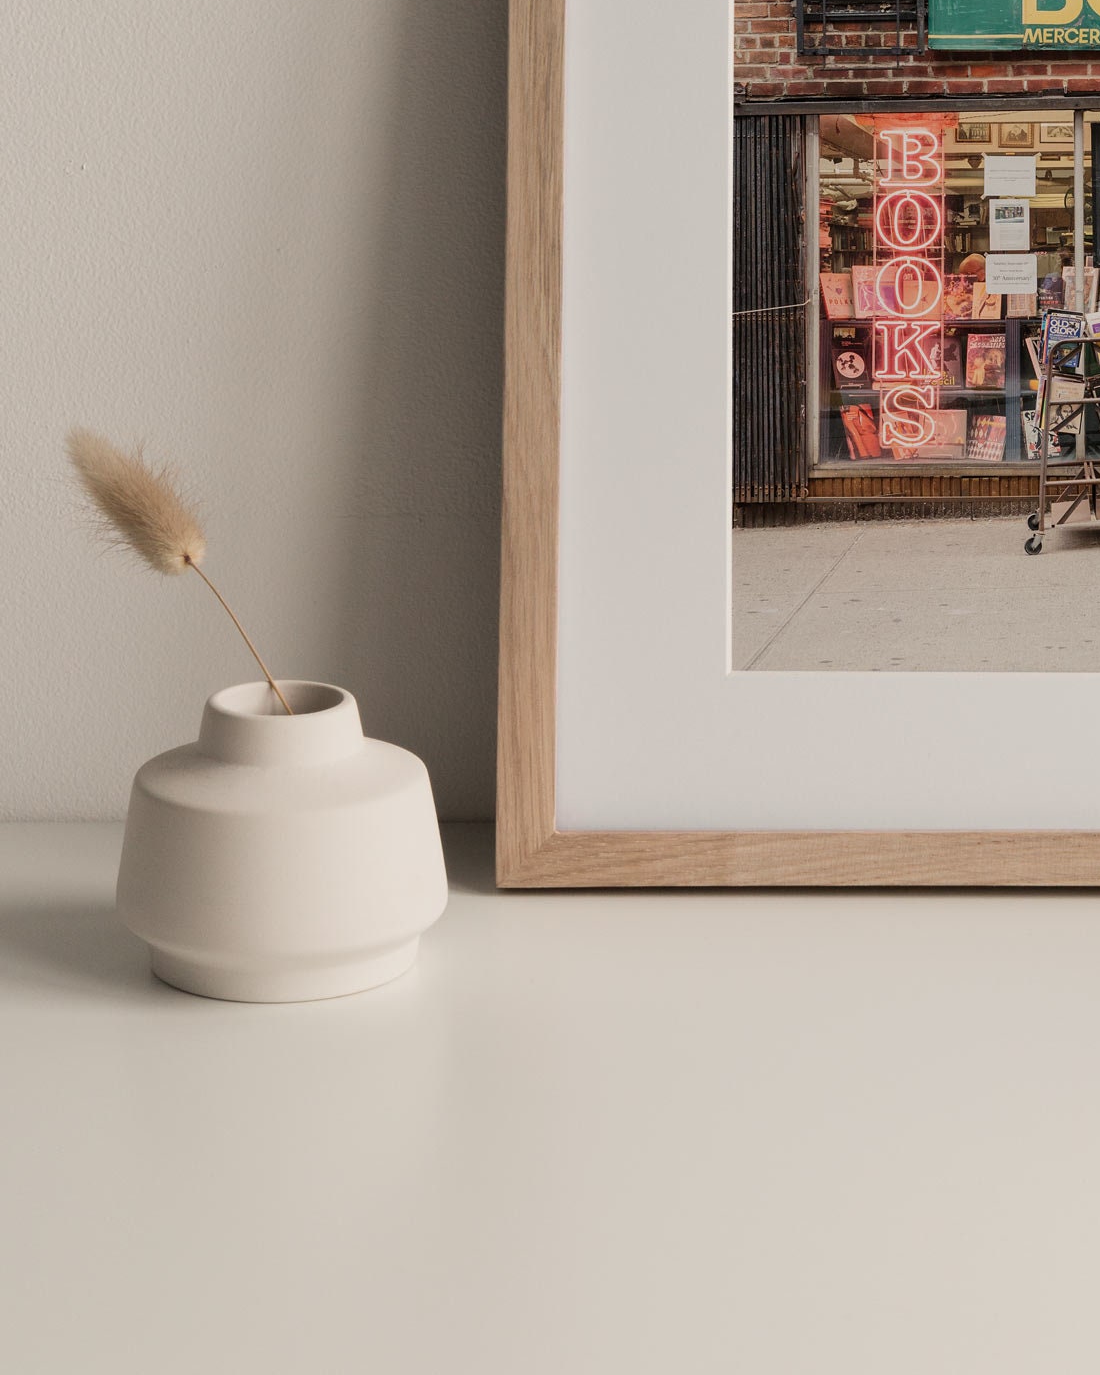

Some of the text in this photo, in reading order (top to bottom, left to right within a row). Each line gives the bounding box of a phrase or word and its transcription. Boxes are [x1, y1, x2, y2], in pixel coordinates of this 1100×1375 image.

[1022, 27, 1100, 44] MERCER
[876, 129, 942, 447] BOOKS
[1050, 319, 1069, 327] OLD
[1049, 326, 1079, 336] GLORY
